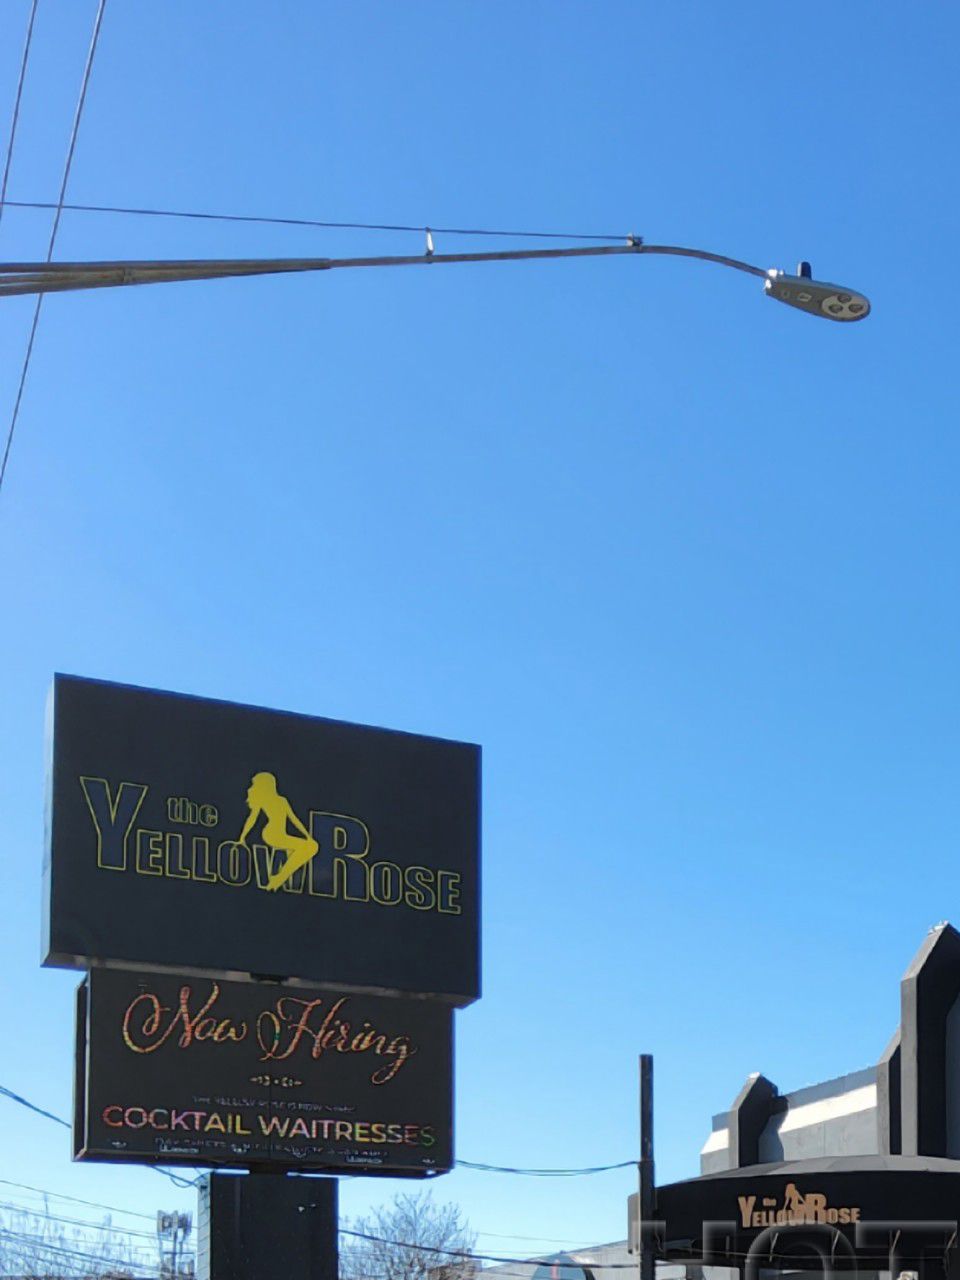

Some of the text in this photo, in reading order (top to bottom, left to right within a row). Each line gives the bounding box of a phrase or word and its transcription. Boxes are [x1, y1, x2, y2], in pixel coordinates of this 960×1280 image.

[166, 796, 219, 828] the
[80, 775, 462, 915] YELLOW ROSE
[122, 982, 417, 1085] Now Hiring
[102, 1105, 252, 1136] COCKTAIL
[258, 1114, 436, 1147] WAITRESSES
[737, 1193, 861, 1228] YELLOW ROSE
